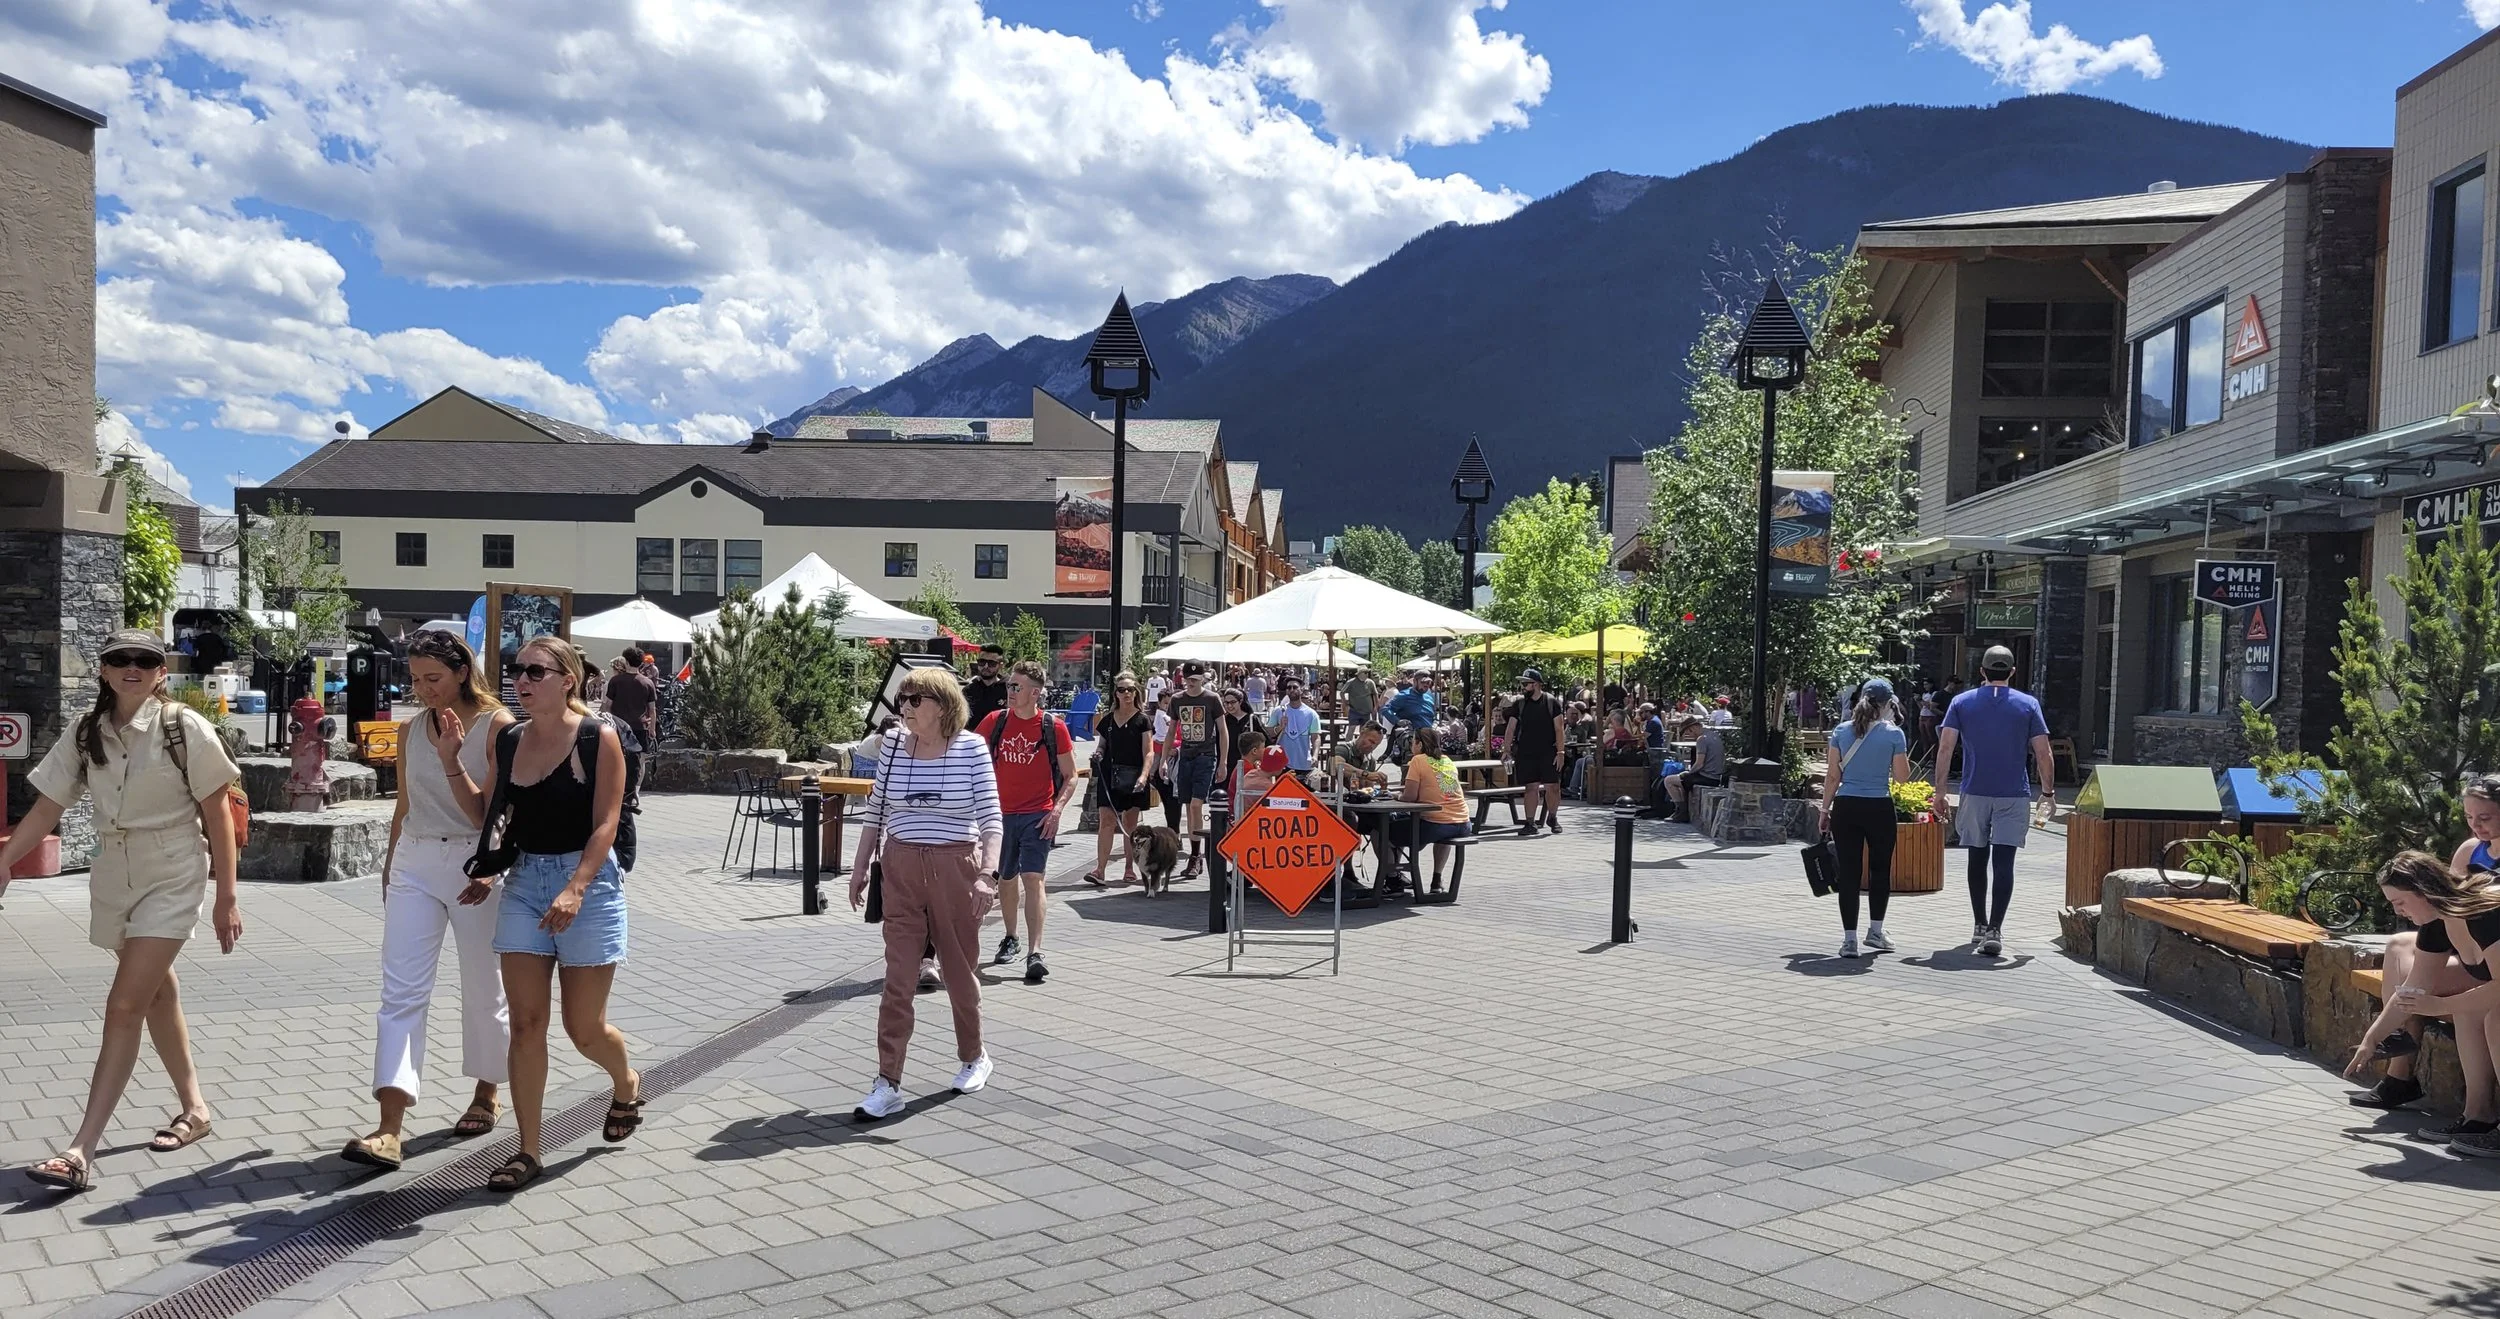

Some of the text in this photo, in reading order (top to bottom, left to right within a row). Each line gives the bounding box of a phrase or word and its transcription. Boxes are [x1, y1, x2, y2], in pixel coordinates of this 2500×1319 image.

[2229, 363, 2268, 401] CMH
[2417, 491, 2469, 527] CMH
[1795, 573, 1817, 584] Banff
[2211, 567, 2262, 583] CMH
[2245, 646, 2270, 665] CMH
[1002, 750, 1035, 765] 1867
[1272, 799, 1301, 808] Saturday
[1258, 815, 1319, 840] ROAD
[1246, 844, 1335, 870] CLOSED
